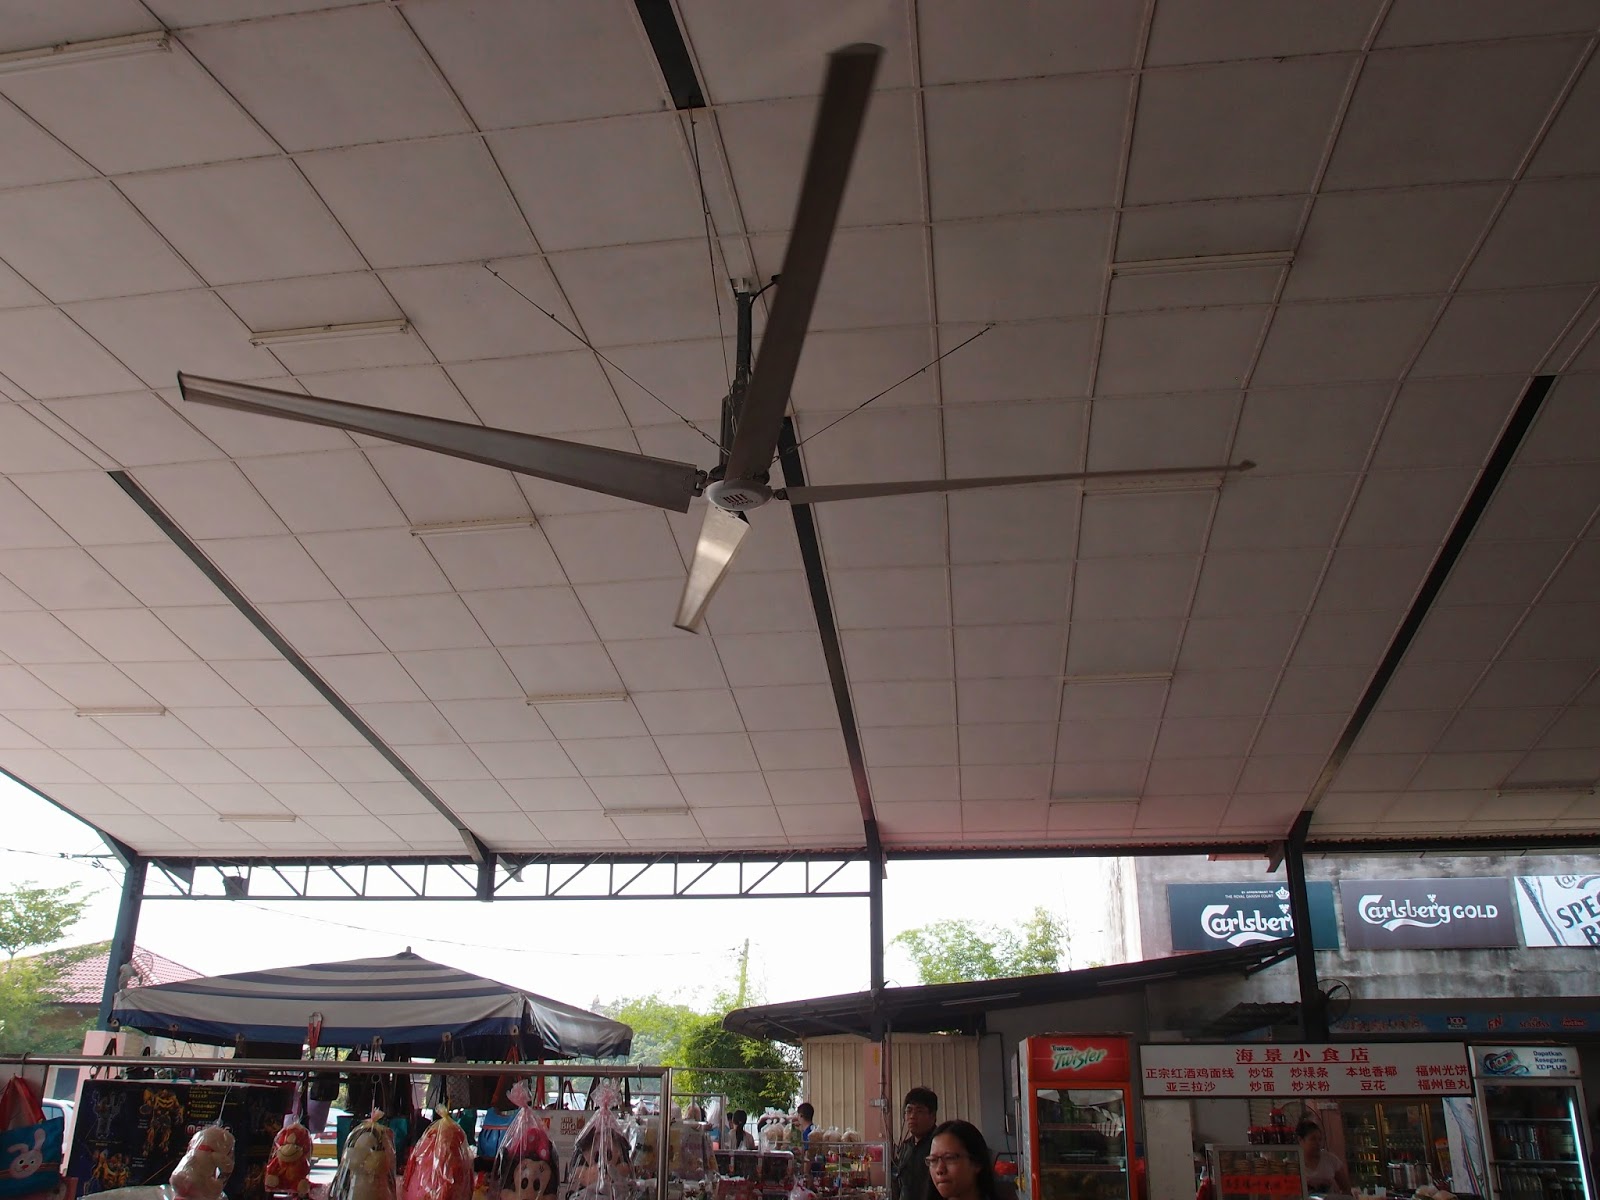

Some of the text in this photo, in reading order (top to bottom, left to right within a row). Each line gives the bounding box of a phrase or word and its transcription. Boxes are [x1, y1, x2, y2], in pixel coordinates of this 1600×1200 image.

[1358, 894, 1498, 930] Carlsberg GOLD
[1556, 888, 1600, 929] SPE
[1200, 904, 1294, 939] Carlsber
[1053, 1048, 1106, 1070] Twister
[1236, 1047, 1369, 1062] 海景小食店
[1145, 1067, 1235, 1079] 正宗红酒鸡面线
[1248, 1067, 1274, 1079] 炒饭
[1345, 1066, 1398, 1078] 本地香椰
[1415, 1064, 1468, 1076] 福州光饼
[1166, 1078, 1470, 1092] 亚三拉沙 炒面 炒米粉 豆花 福州鱼丸
[561, 1122, 576, 1130] BIG
